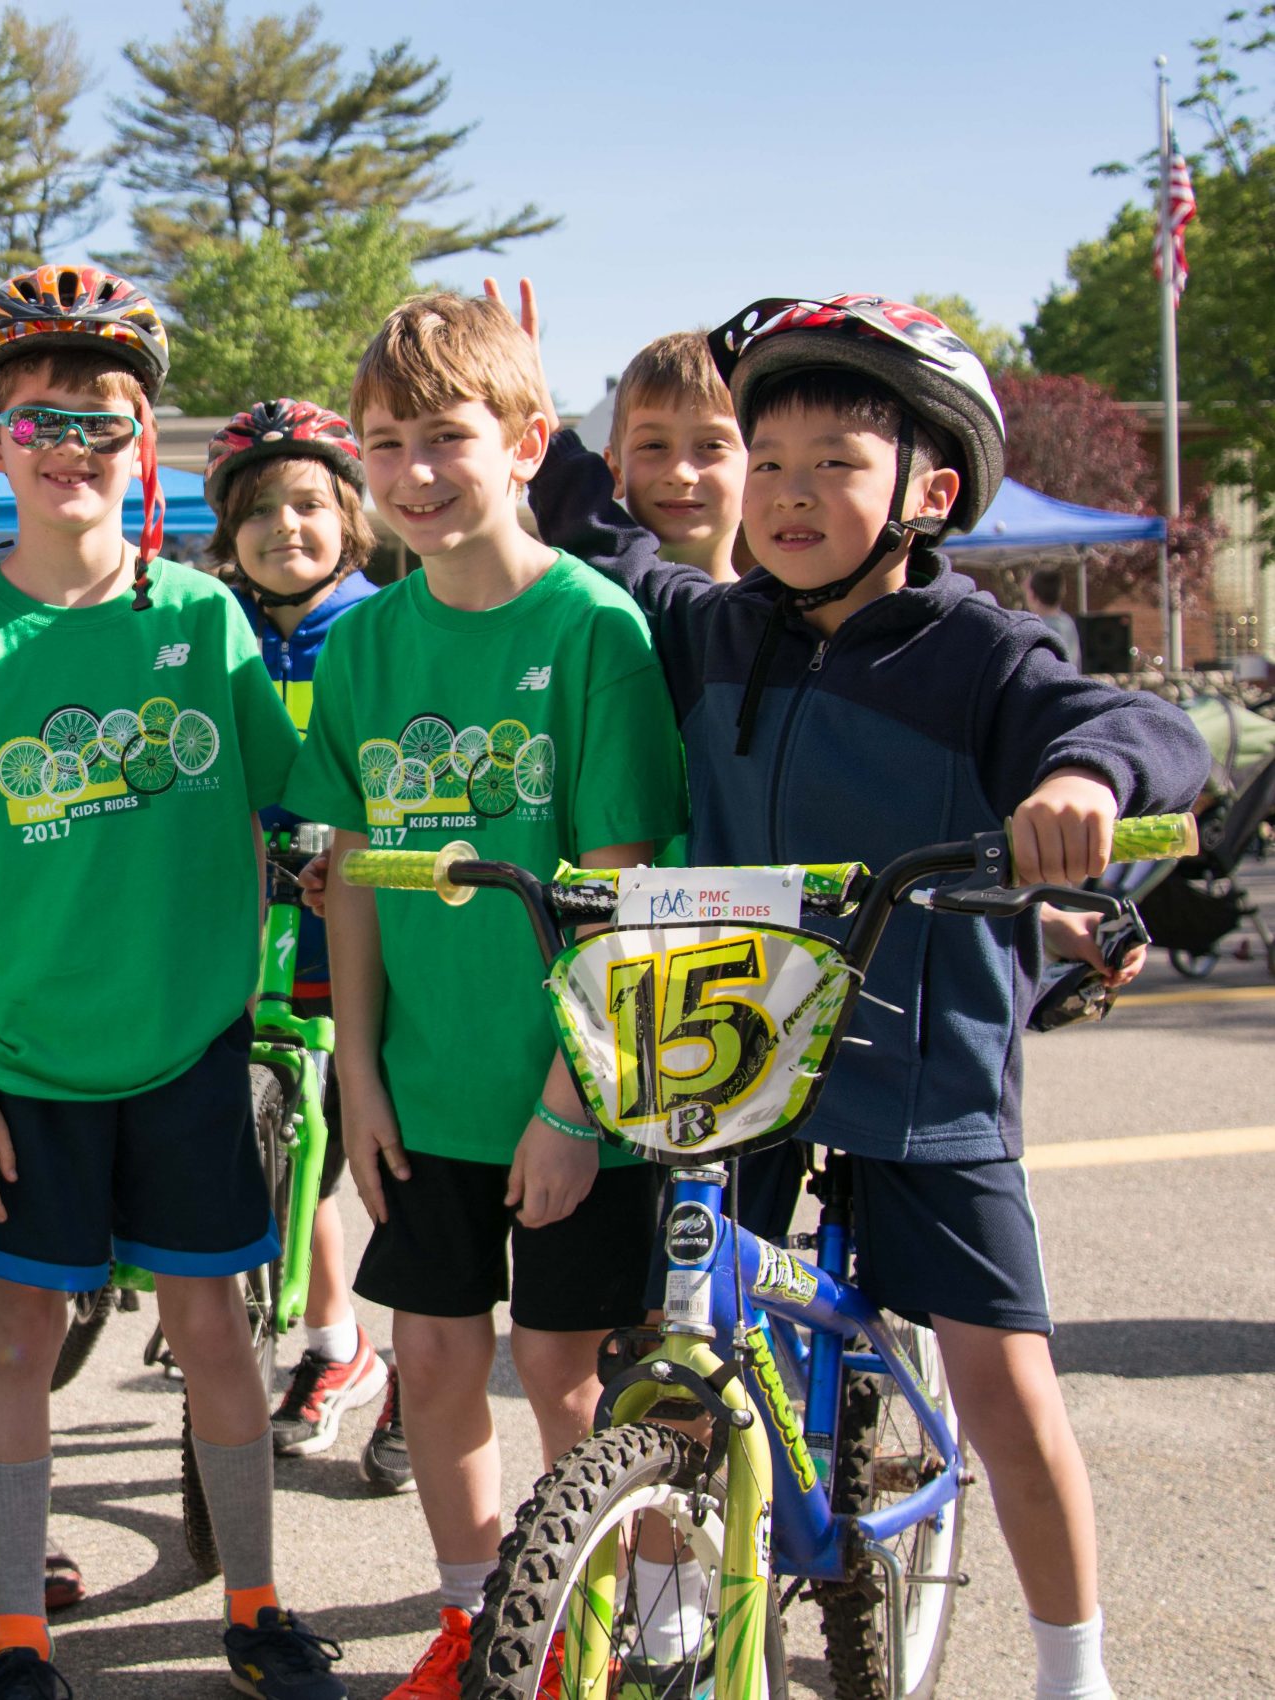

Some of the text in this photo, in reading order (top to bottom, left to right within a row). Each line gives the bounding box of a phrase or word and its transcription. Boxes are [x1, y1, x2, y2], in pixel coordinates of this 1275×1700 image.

[27, 796, 138, 819] PMC KIDS RIDES
[372, 807, 477, 828] PMC KIDS RIDES
[22, 818, 71, 844] 2017
[371, 827, 408, 846] 2017
[699, 890, 730, 902] PMC
[699, 905, 771, 917] KIDS RIDES
[782, 972, 830, 1036] pressure
[607, 934, 776, 1123] 15
[671, 1237, 709, 1247] MAGNA
